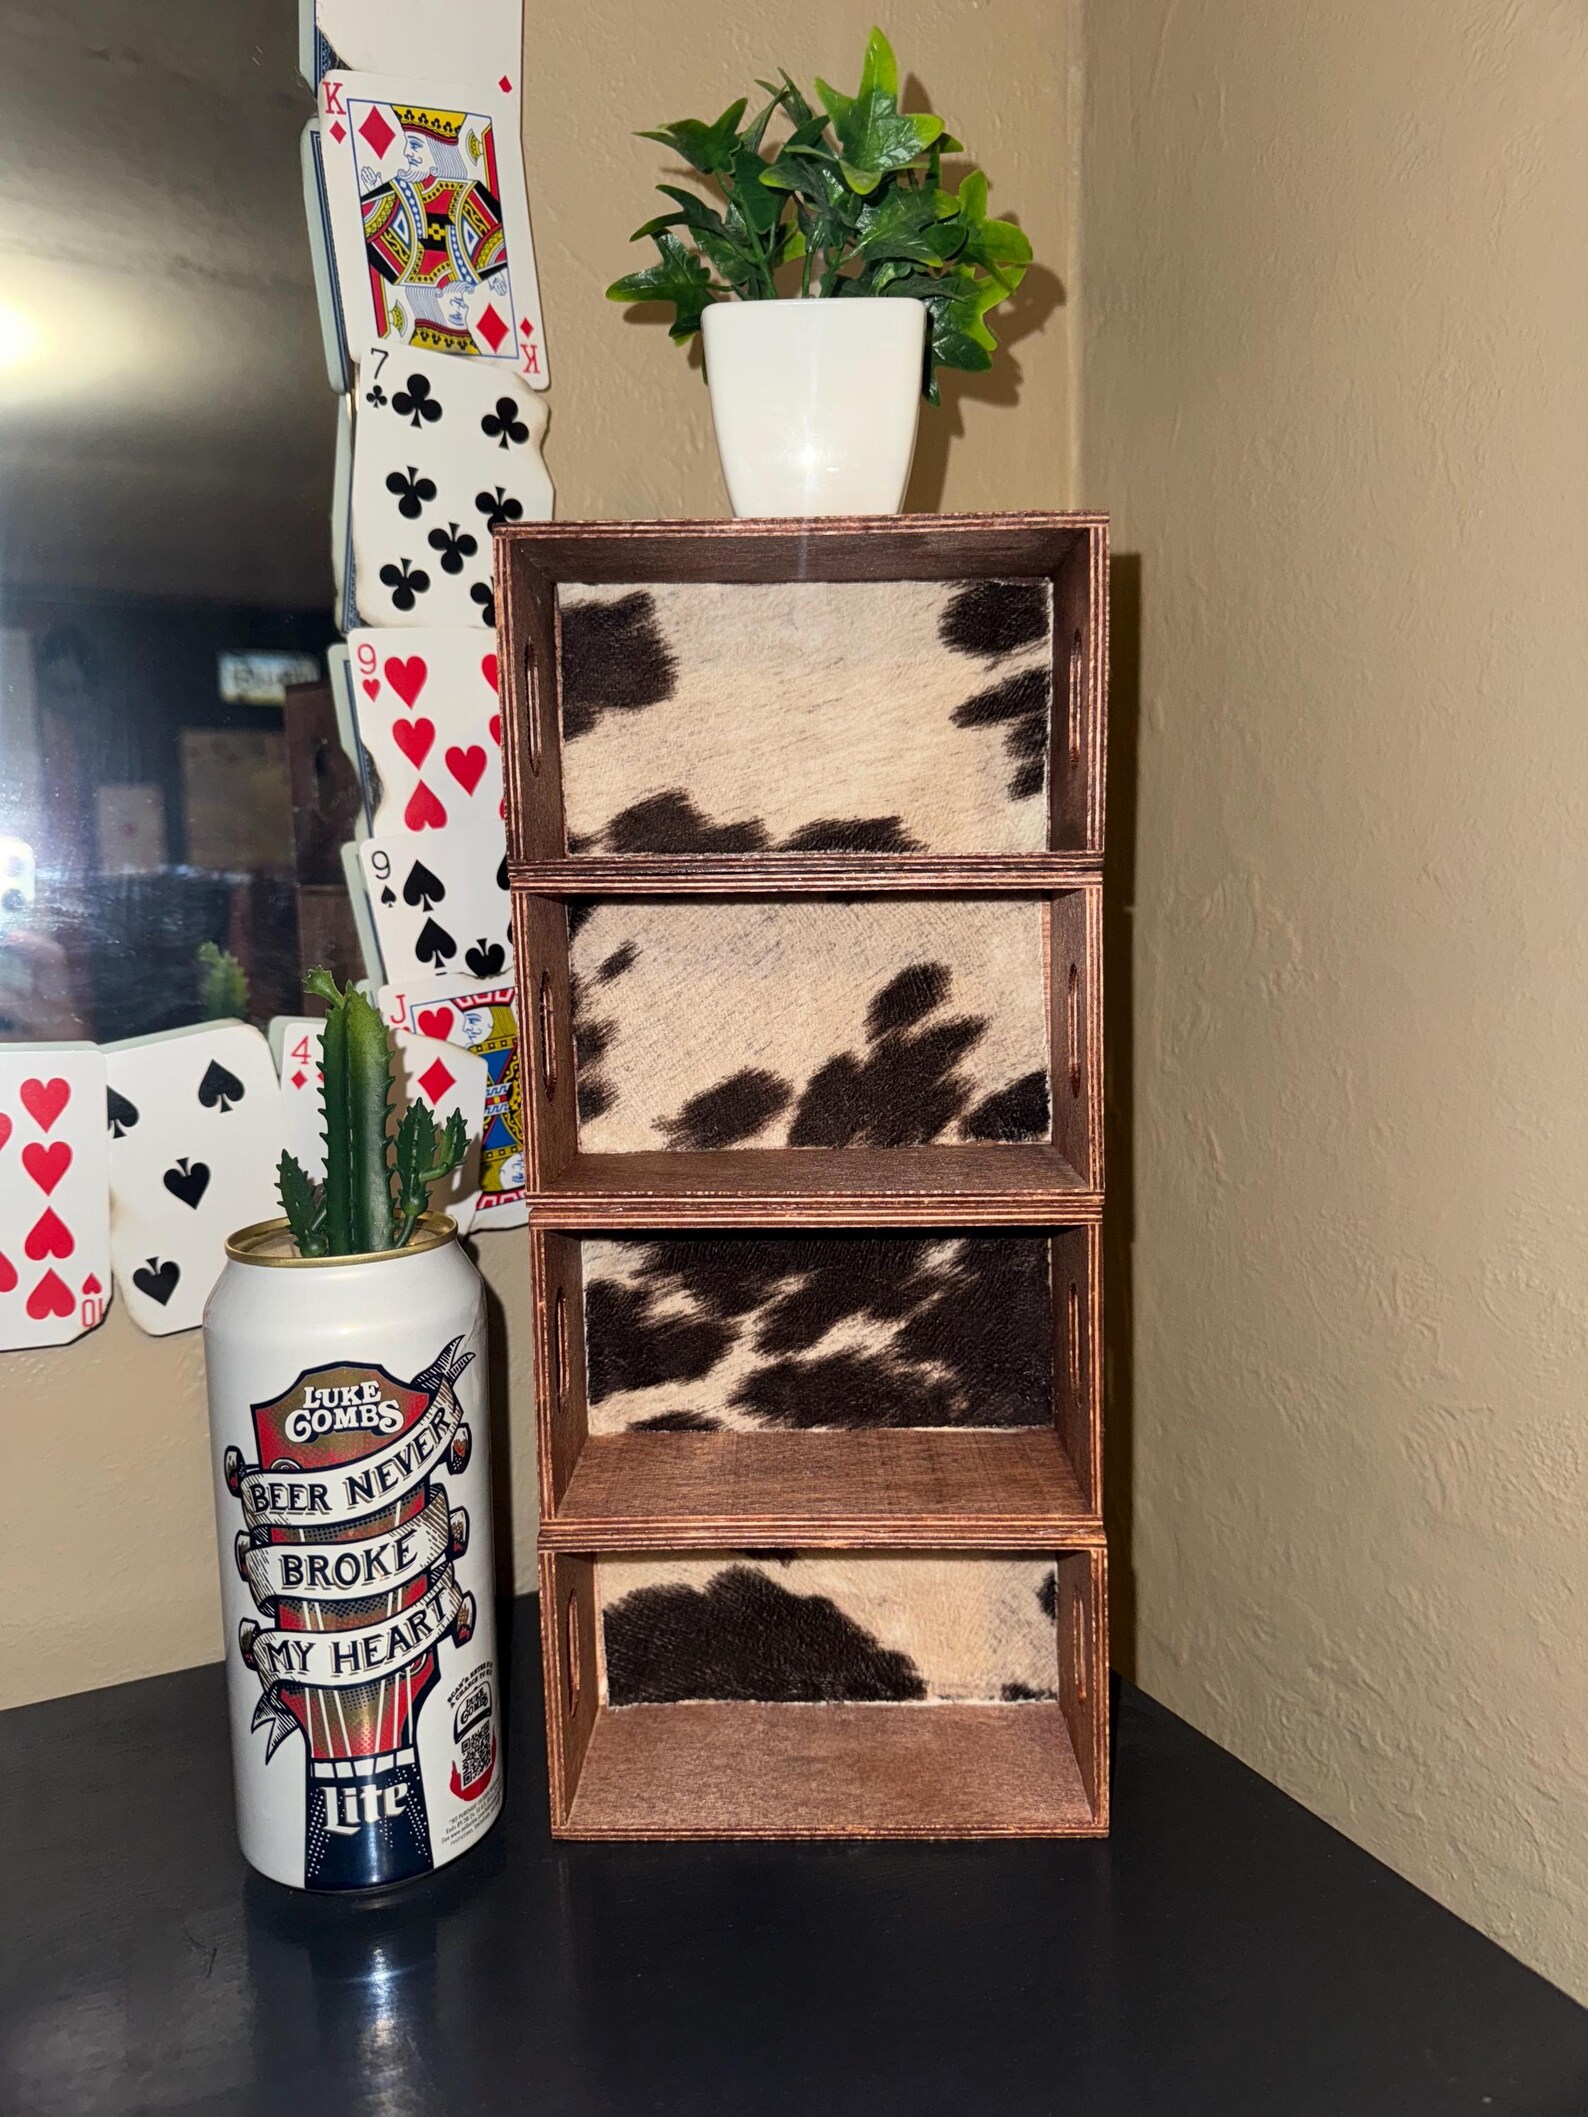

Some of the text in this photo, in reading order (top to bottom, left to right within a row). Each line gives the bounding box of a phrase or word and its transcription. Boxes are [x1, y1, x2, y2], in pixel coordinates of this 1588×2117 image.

[322, 82, 346, 115] K
[371, 348, 389, 380] 7
[521, 344, 540, 374] K
[357, 643, 377, 675] 9
[371, 850, 391, 880] 9
[390, 994, 406, 1025] J
[291, 1035, 312, 1065] 4
[303, 1380, 381, 1408] LUKE
[285, 1398, 404, 1443] COMBS
[249, 1406, 453, 1516] BEER NEVER
[281, 1532, 418, 1590] BROKE
[263, 1588, 448, 1678] MY HEART
[321, 1784, 410, 1836] Lite
